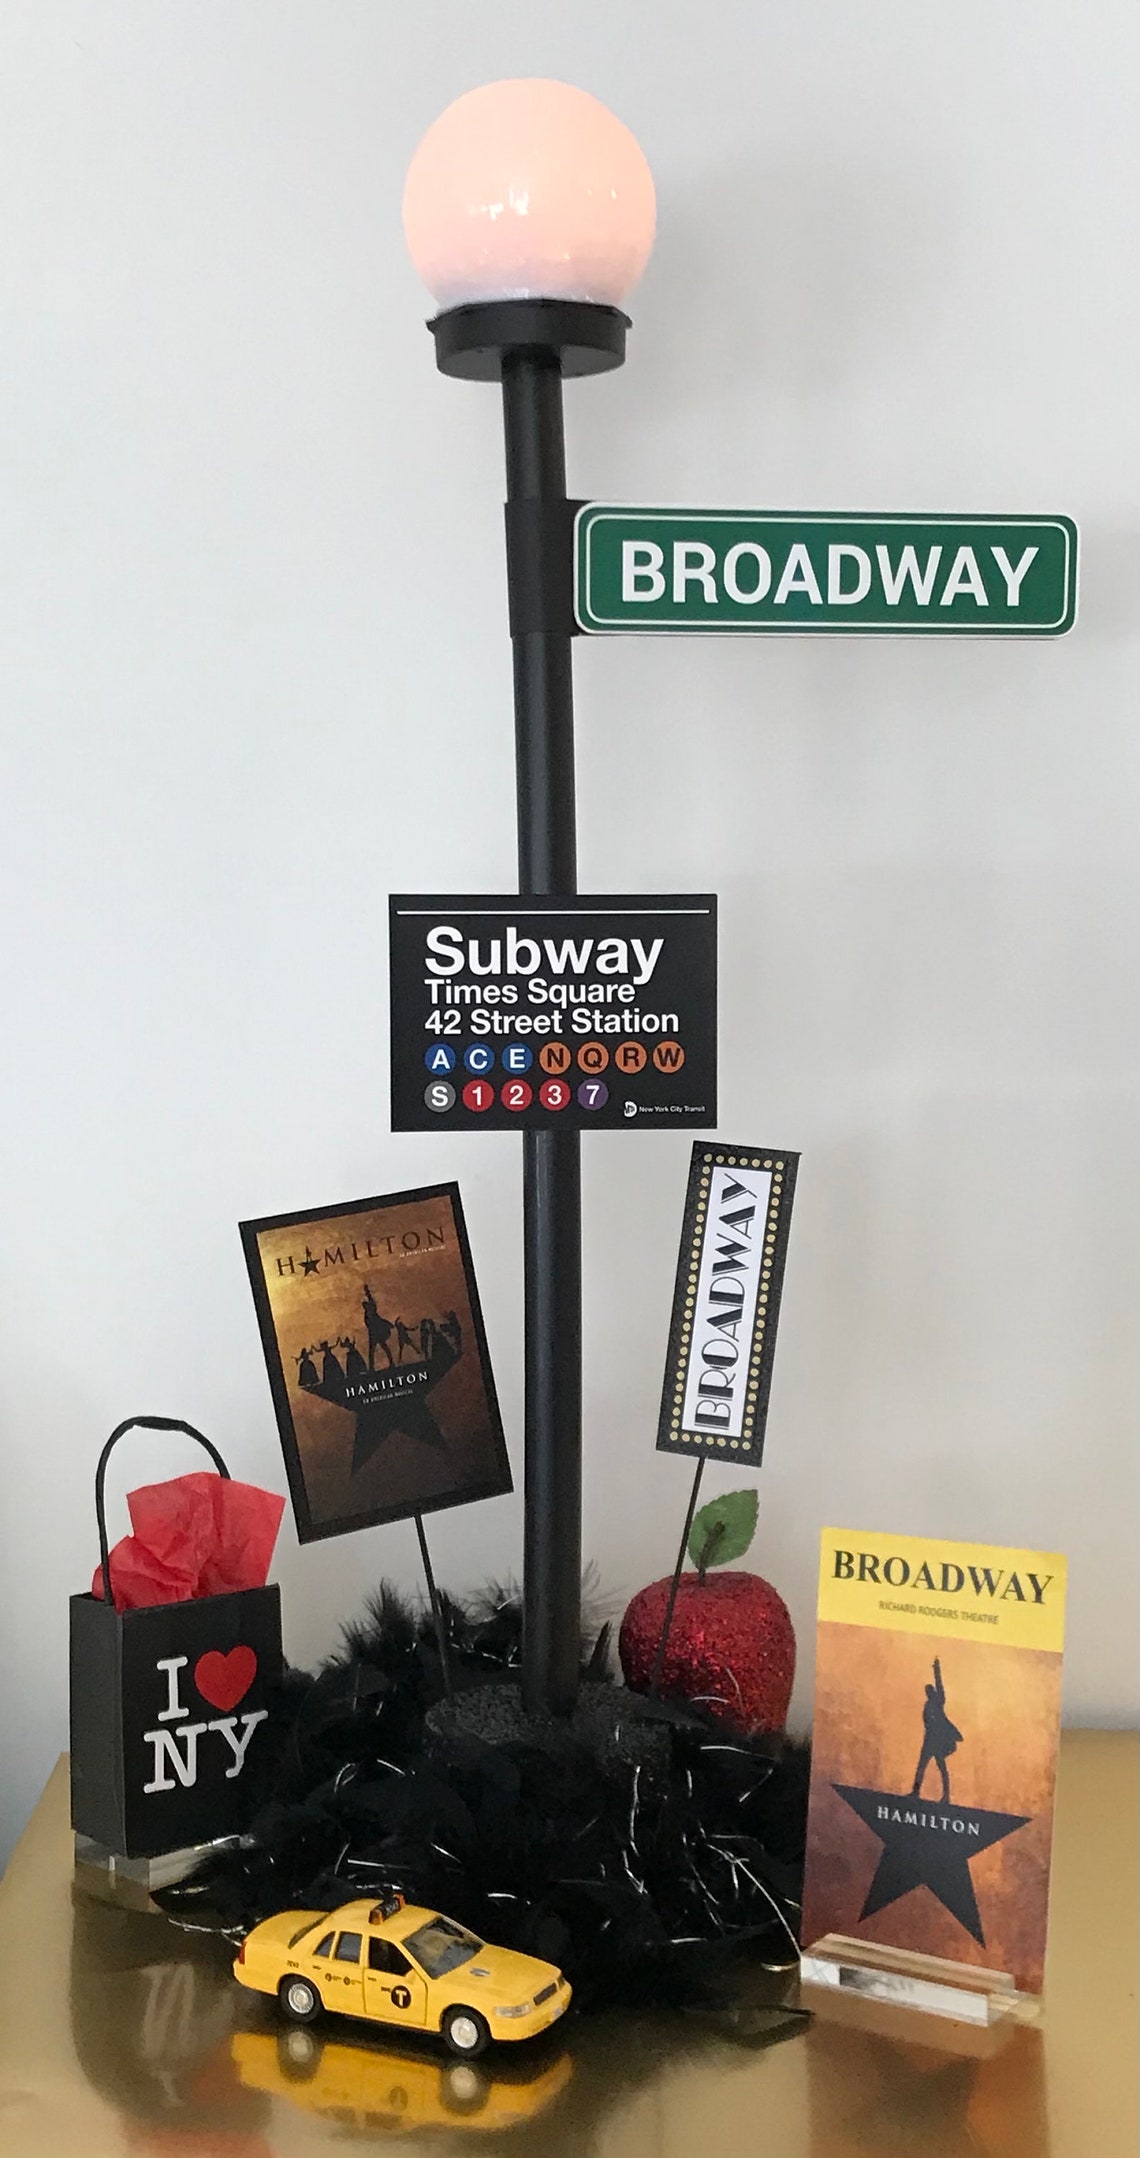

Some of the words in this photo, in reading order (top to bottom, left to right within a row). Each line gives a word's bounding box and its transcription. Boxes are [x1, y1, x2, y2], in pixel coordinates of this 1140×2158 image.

[621, 539, 1039, 607] BROADWAY
[424, 925, 664, 985] Subway
[424, 978, 519, 1005] Times
[527, 977, 636, 1009] Square
[424, 1009, 462, 1035] 42
[470, 1008, 563, 1035] Street
[571, 1008, 679, 1034] Station
[431, 1049, 450, 1070] A
[469, 1048, 488, 1070] C
[508, 1048, 525, 1069] E
[546, 1047, 565, 1069] N
[583, 1047, 602, 1069] Q
[622, 1047, 640, 1068] R
[656, 1046, 682, 1067] W
[431, 1086, 448, 1108] S
[471, 1086, 483, 1106] 1
[509, 1085, 524, 1106] 2
[546, 1085, 562, 1106] 3
[585, 1085, 600, 1105] 7
[639, 1105, 654, 1113] New
[654, 1105, 669, 1113] York
[669, 1105, 683, 1113] City
[693, 1172, 758, 1431] BROADWAY
[345, 1371, 428, 1398] HAMILTON
[831, 1549, 1054, 1605] BROADWAY
[878, 1600, 917, 1614] RICHARD
[918, 1605, 959, 1620] RODGERS
[960, 1611, 999, 1625] THEATRE
[156, 1655, 190, 1722] I
[143, 1708, 269, 1795] NY
[877, 1804, 981, 1837] HAMILTON
[395, 1989, 408, 2007] T
